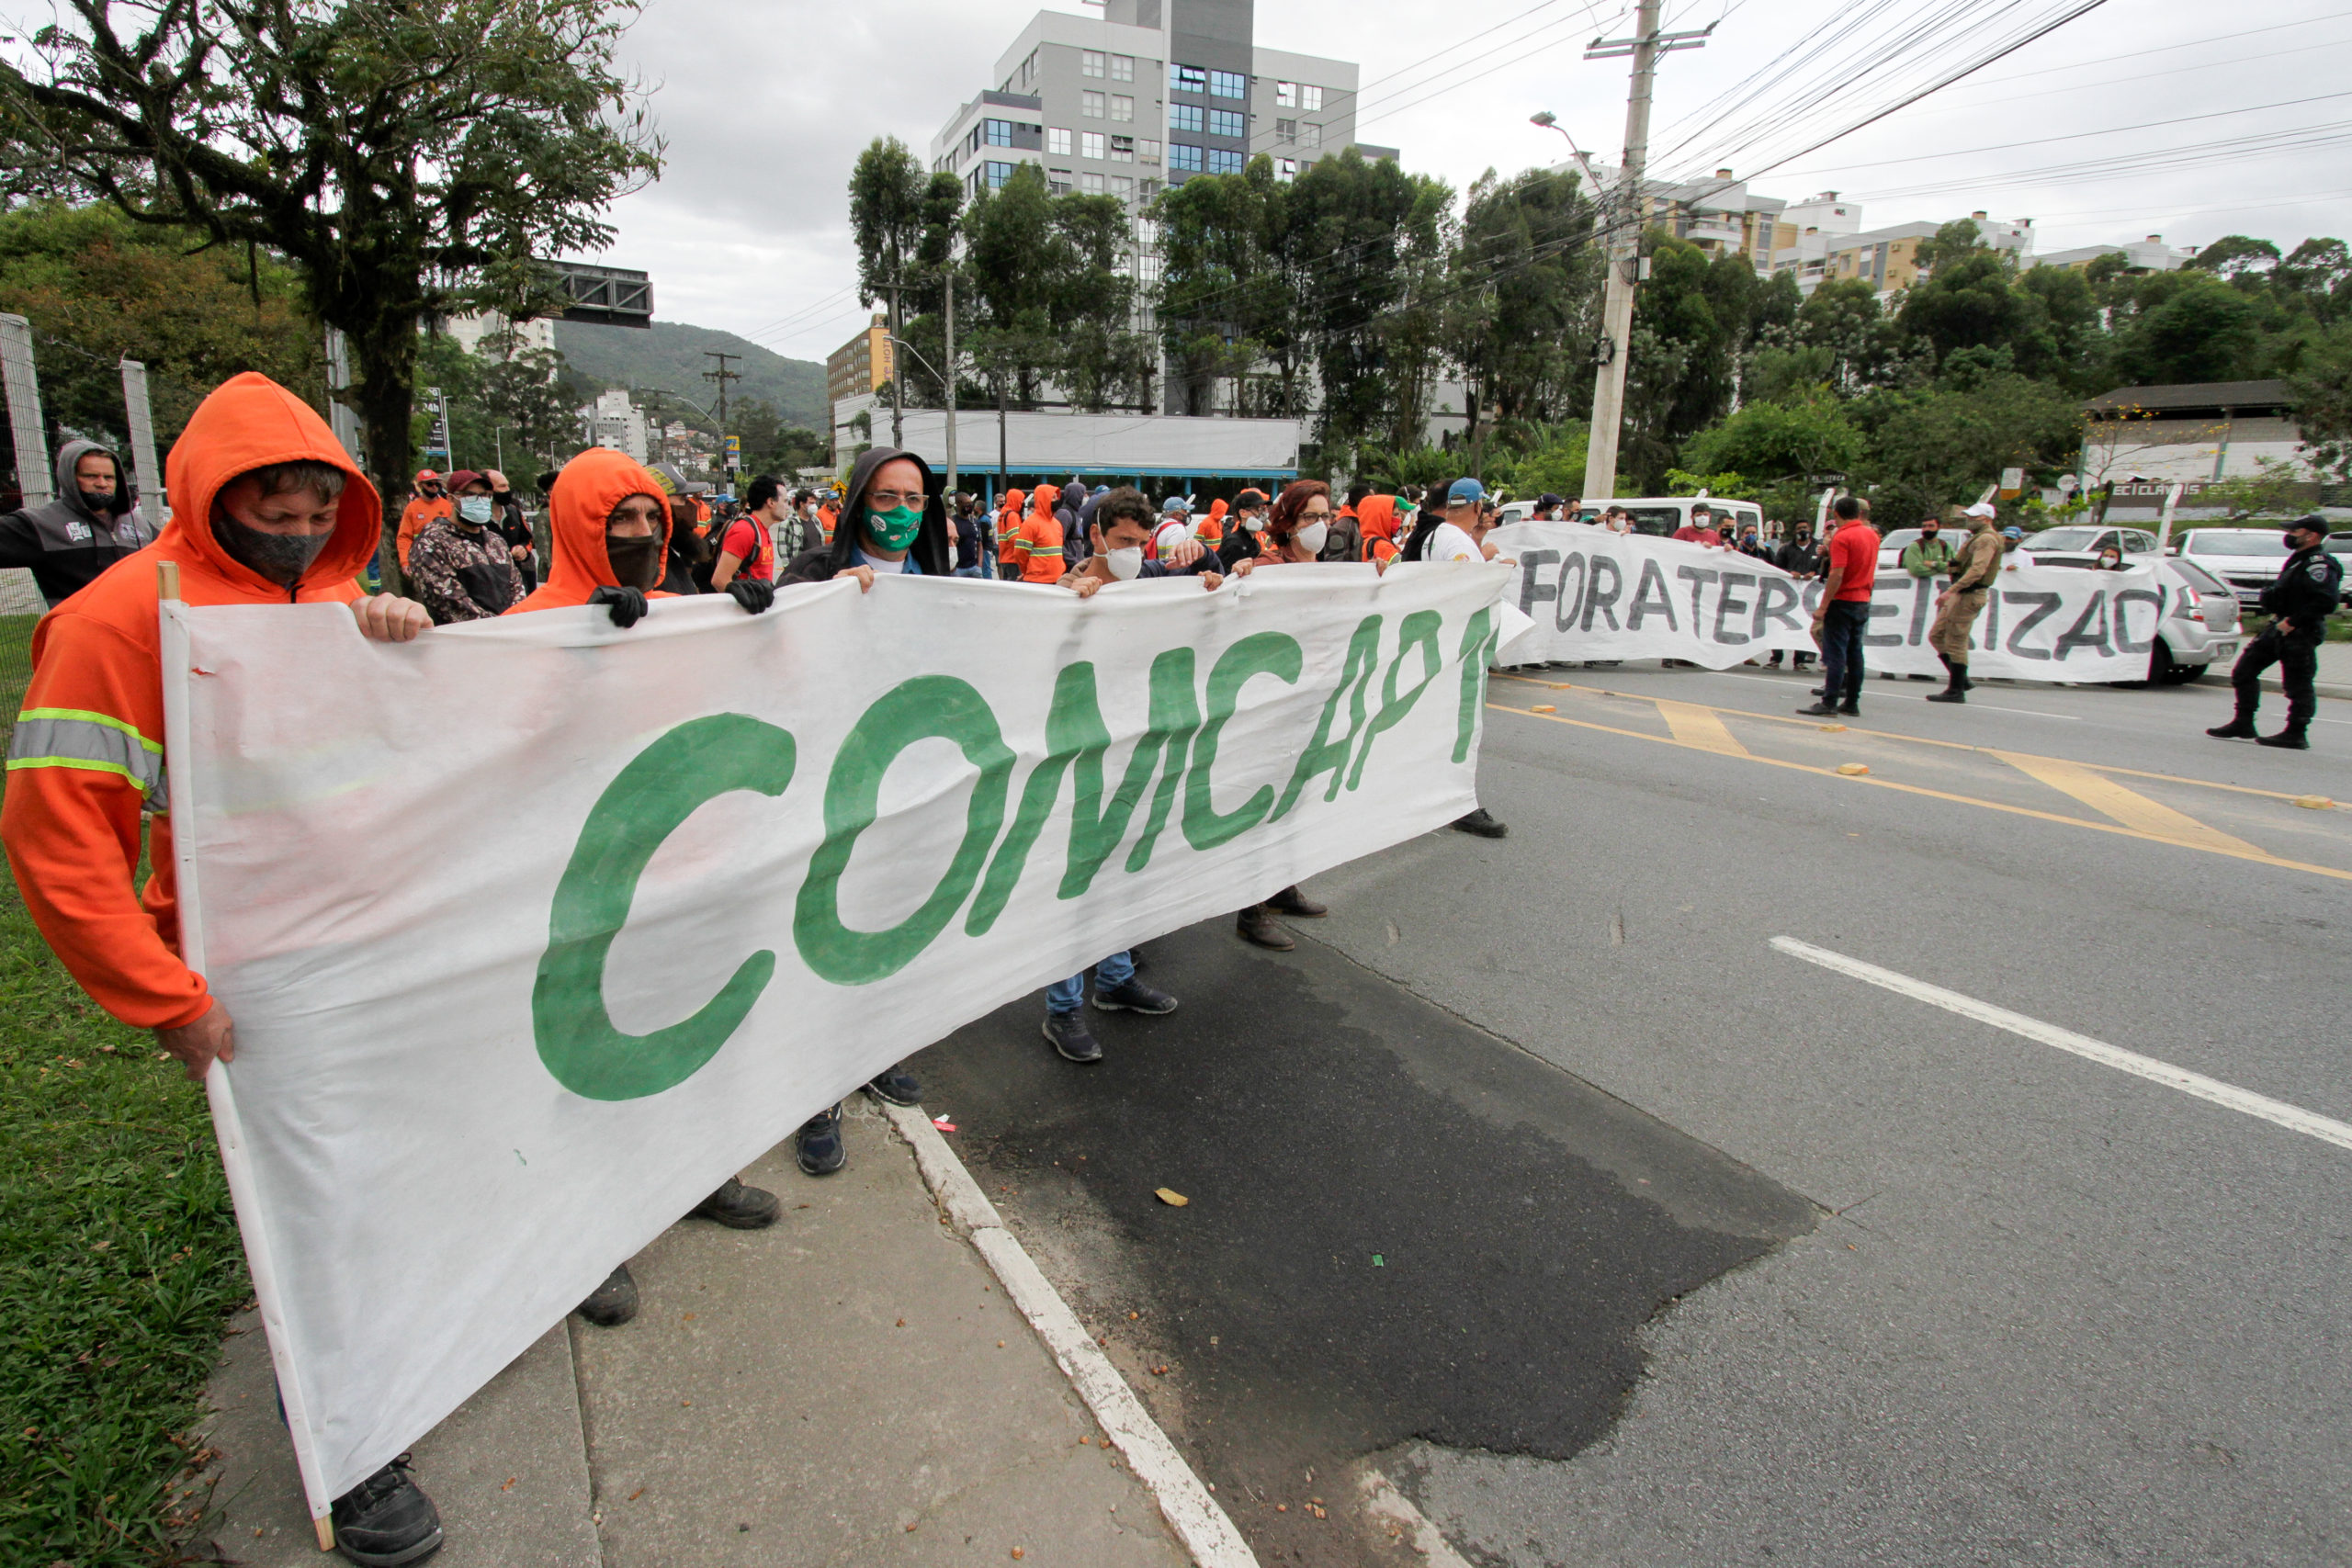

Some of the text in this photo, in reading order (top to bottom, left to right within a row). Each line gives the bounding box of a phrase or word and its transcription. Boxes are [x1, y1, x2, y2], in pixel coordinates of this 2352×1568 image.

[2112, 483, 2201, 496] ECICLAVIS
[1520, 549, 1678, 634] FORA
[532, 609, 1442, 1101] COMCAP
